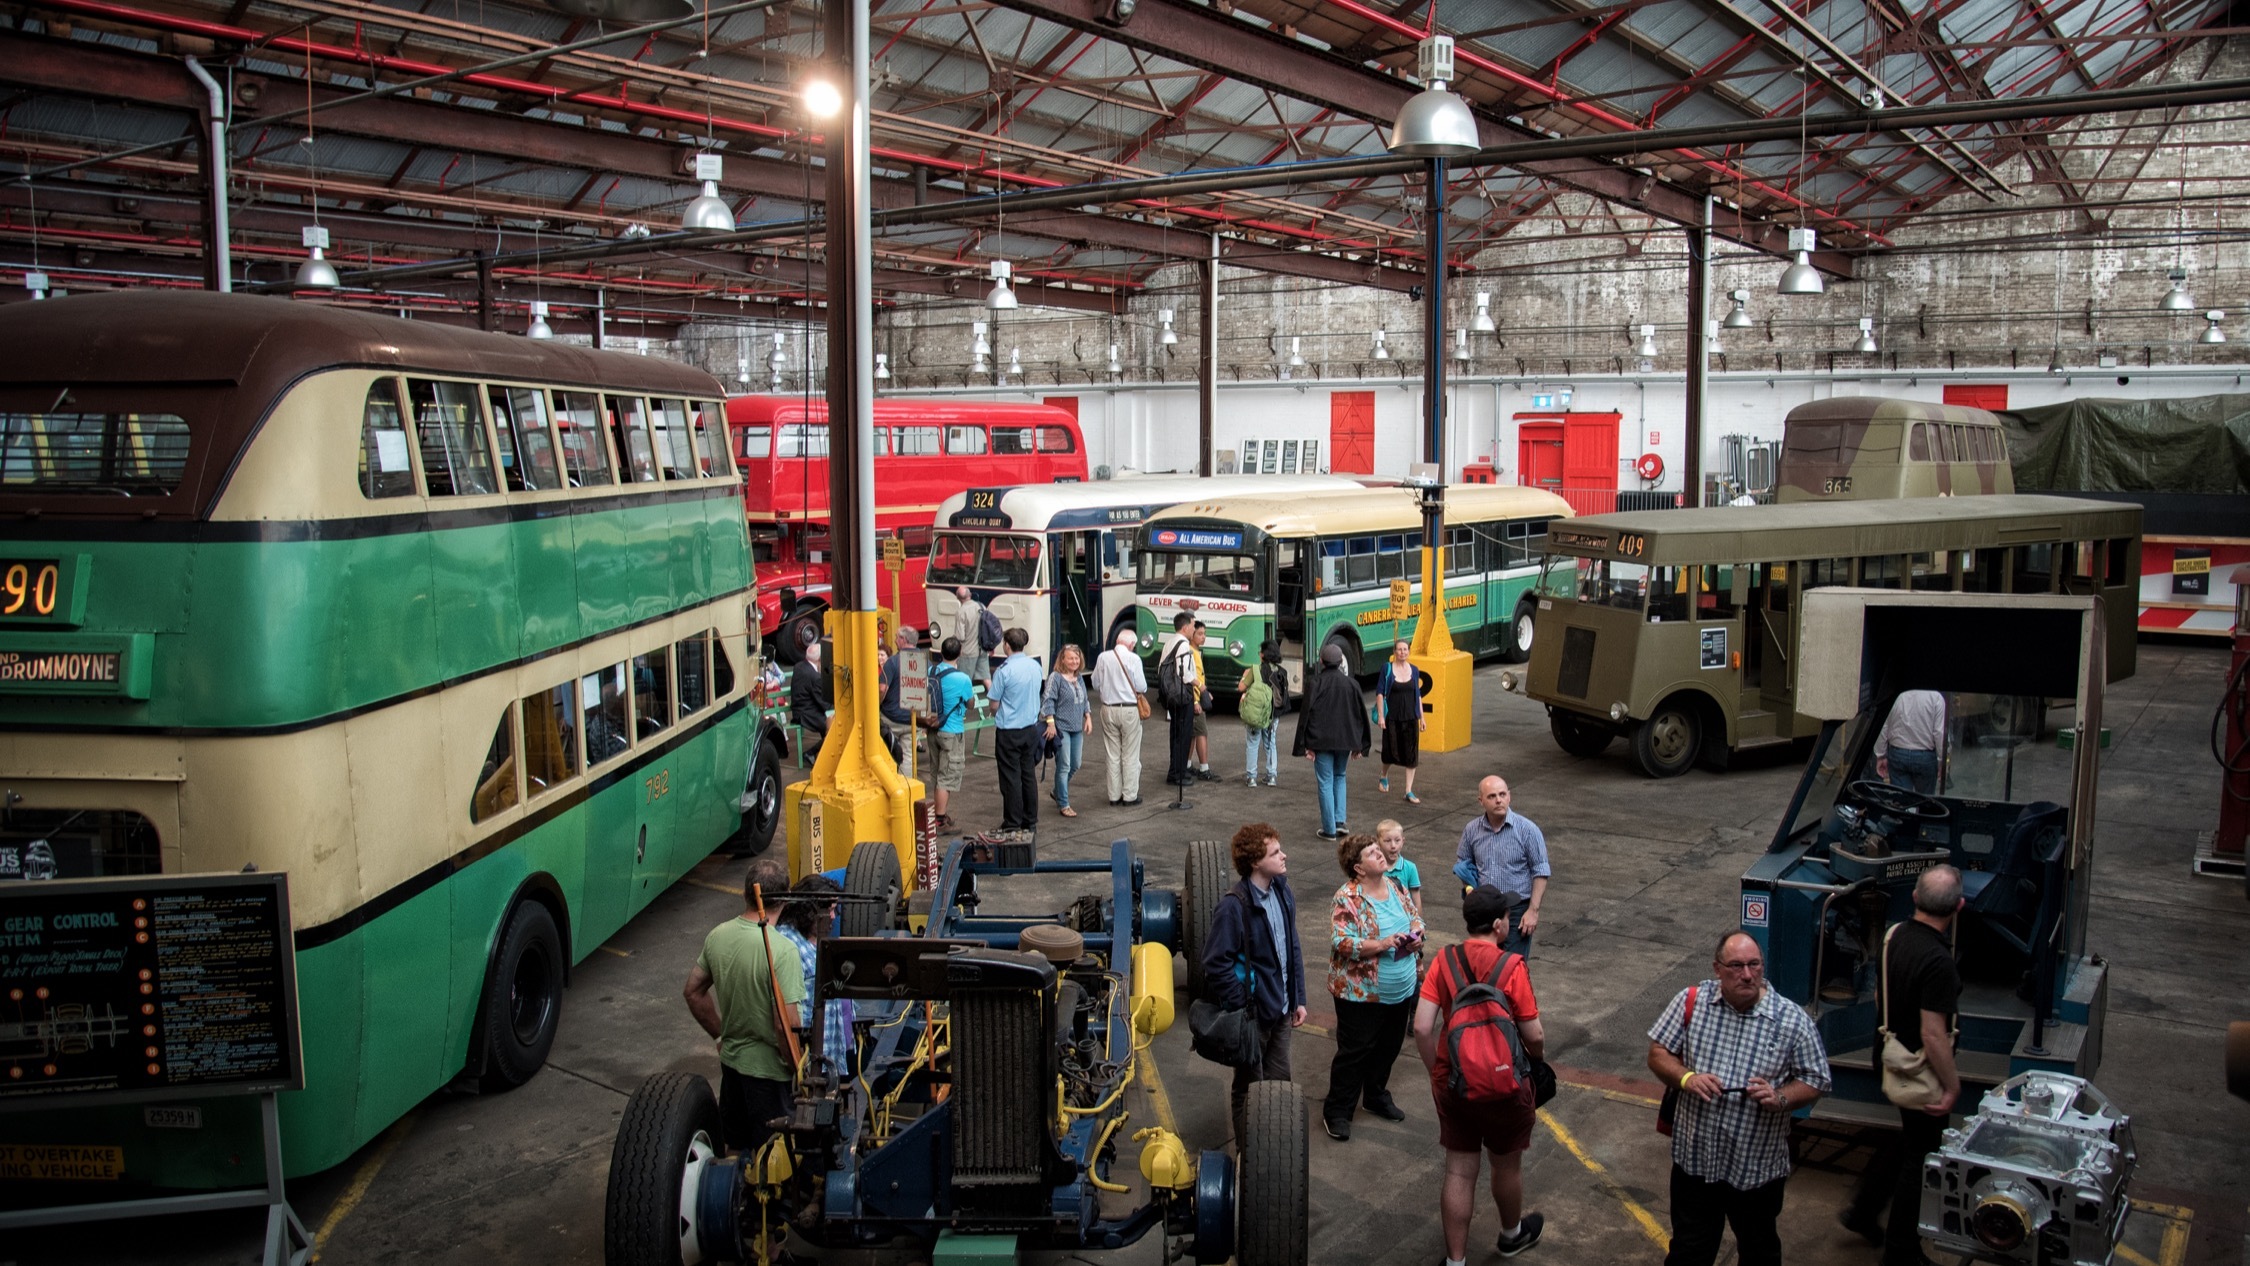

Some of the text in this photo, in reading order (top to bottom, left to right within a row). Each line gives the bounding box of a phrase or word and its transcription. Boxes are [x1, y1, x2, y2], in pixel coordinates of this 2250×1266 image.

[1825, 479, 1851, 494] 365
[973, 492, 995, 508] 324
[962, 517, 1002, 527] CIRCULAR QUAY
[1179, 533, 1190, 544] ALL
[1190, 534, 1222, 546] AMERICAN
[1222, 535, 1236, 546] BUS
[1618, 533, 1644, 558] 409
[4, 563, 58, 615] 90
[1393, 584, 1405, 593] BUS
[1149, 597, 1173, 607] LEVER
[1207, 602, 1248, 613] COACHES
[1391, 594, 1406, 603] STOP
[1356, 608, 1393, 627] CANBERR
[1448, 594, 1477, 611] CHARTER
[1, 653, 116, 682] DRUMMOYNE
[908, 660, 918, 672] NO
[901, 676, 926, 690] STANDING
[645, 768, 669, 805] 792
[812, 816, 821, 838] BUS
[927, 804, 940, 891] WAIT HERE FOR
[813, 845, 822, 874] STOP
[1886, 859, 1937, 872] PLEASE ASSIST BY
[1886, 869, 1904, 878] PAYING
[1903, 867, 1920, 876] EXACT
[4, 912, 119, 933] GEAR CONTROL
[23, 1148, 117, 1162] OVERTAKE
[38, 1163, 114, 1178] VEHICLE
